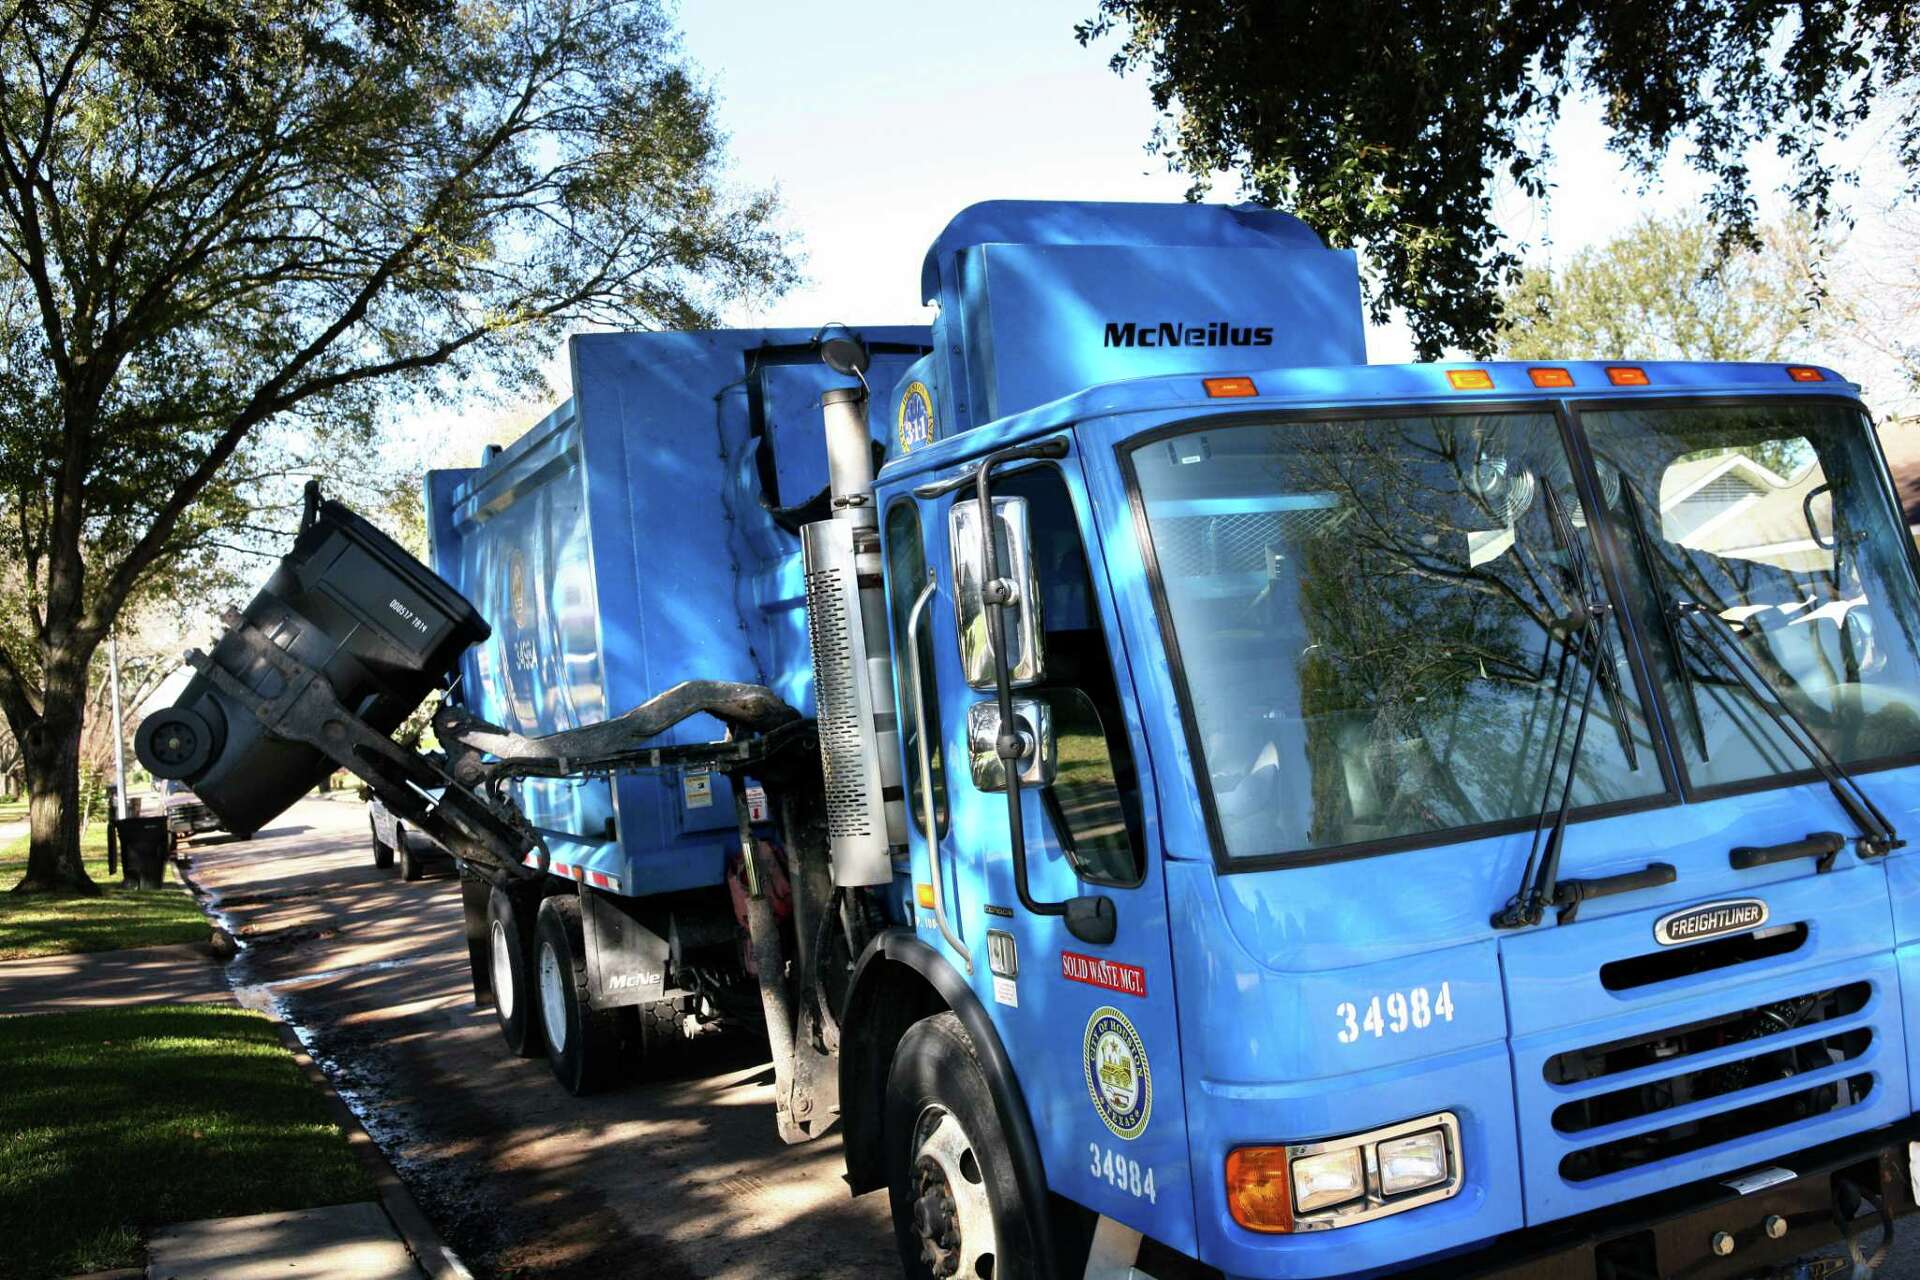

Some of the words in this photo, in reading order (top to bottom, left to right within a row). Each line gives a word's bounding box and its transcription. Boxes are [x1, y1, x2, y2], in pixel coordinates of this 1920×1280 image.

[1103, 321, 1274, 348] McNeilus
[1671, 906, 1759, 937] FREIGHTLINER
[1062, 955, 1088, 979] SOLID
[1088, 960, 1119, 987] WASTE
[1119, 967, 1143, 993] MGT.
[1336, 981, 1454, 1043] 34984
[1090, 1031, 1100, 1061] CITY
[1098, 1020, 1109, 1033] OF
[1110, 1020, 1144, 1077] HOUSTON
[1107, 1104, 1137, 1127] TEXAS
[1089, 1142, 1157, 1205] 34984
